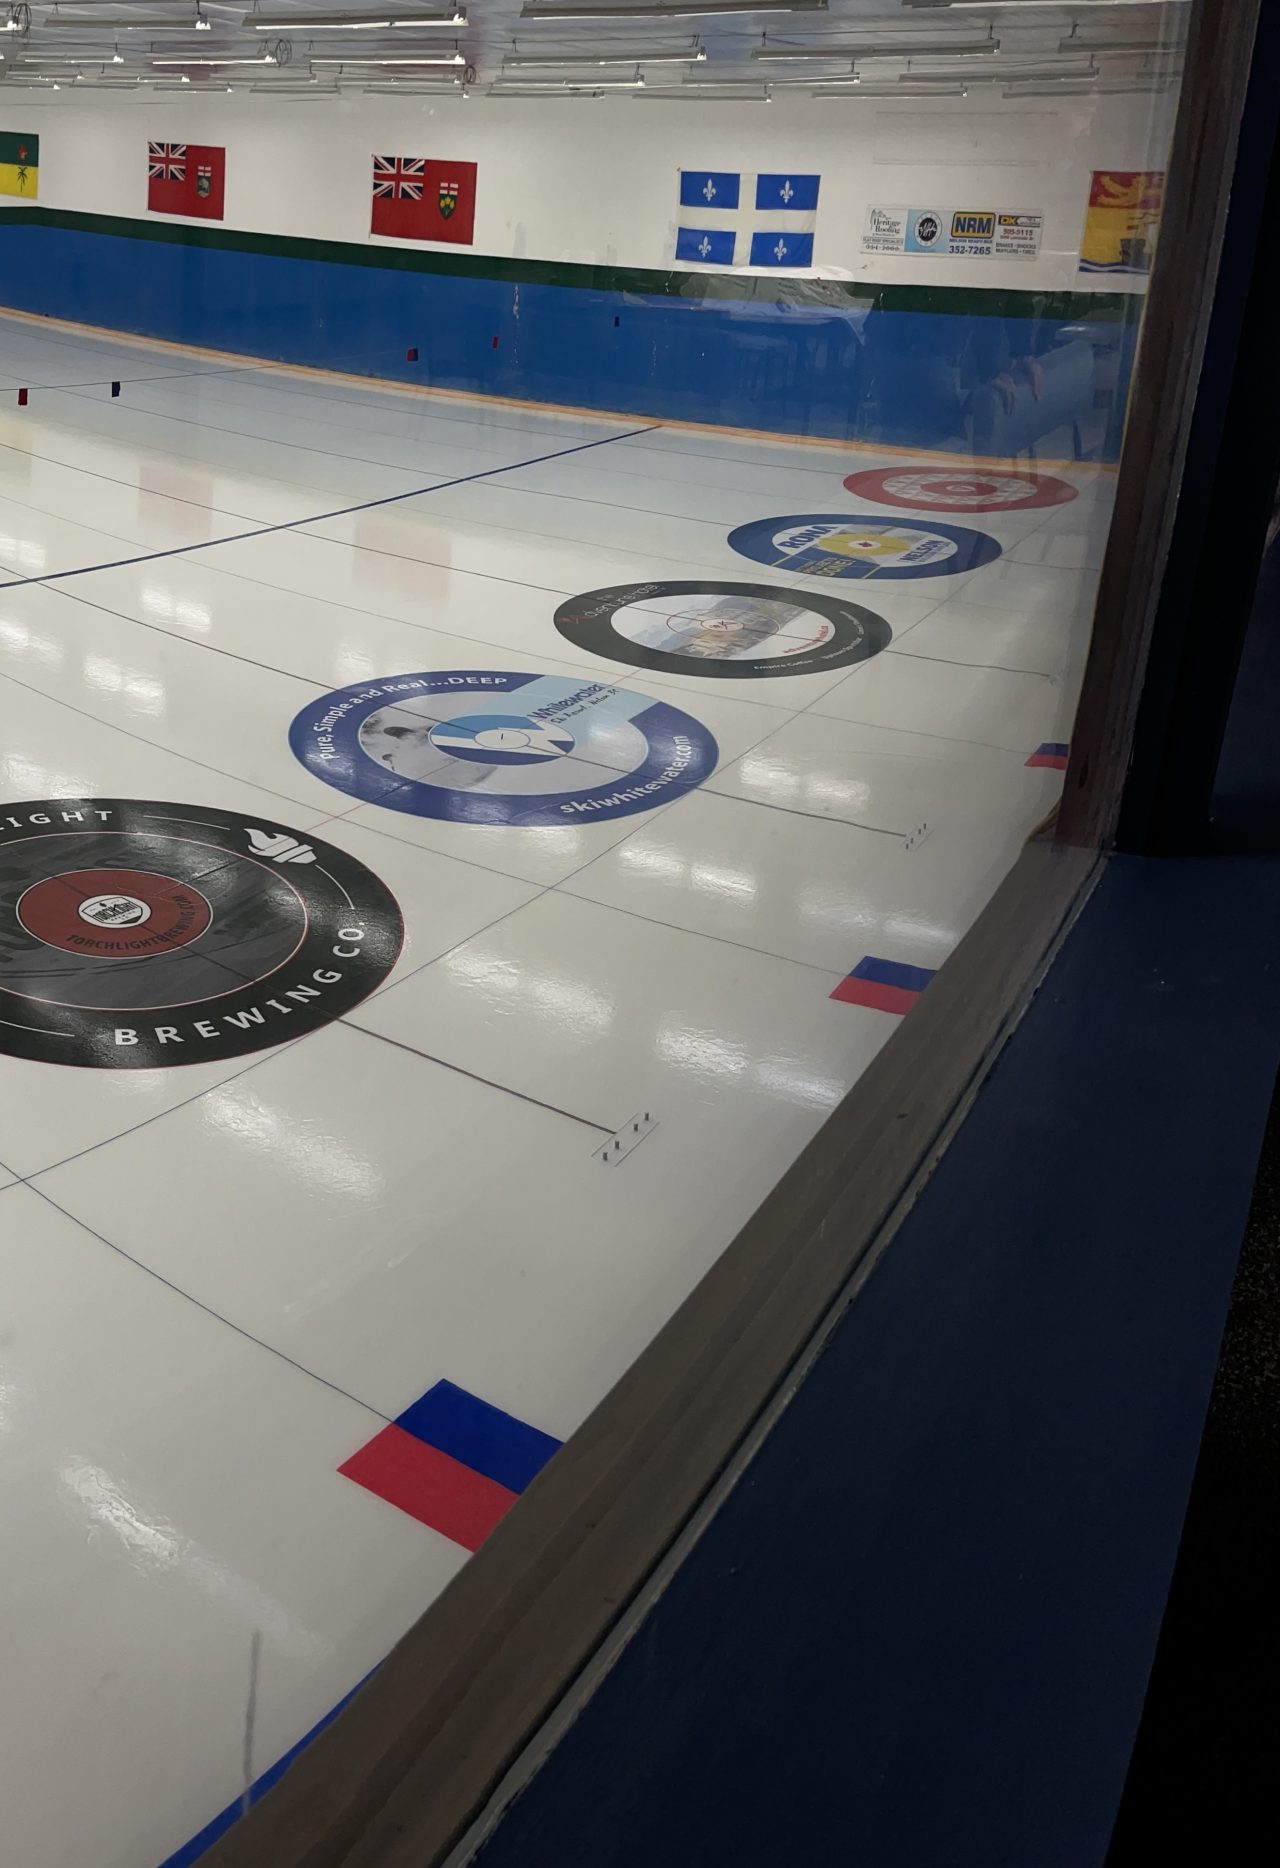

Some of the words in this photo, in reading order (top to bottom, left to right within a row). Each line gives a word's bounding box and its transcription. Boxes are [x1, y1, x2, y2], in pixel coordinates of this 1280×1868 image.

[955, 217, 992, 234] NRM
[949, 245, 991, 255] 352-7265
[777, 526, 838, 548] RONA
[313, 702, 353, 733] Simple
[349, 688, 384, 704] and
[526, 684, 606, 719] Whitewater
[560, 735, 692, 813] skiwhitewater.com
[114, 968, 343, 1046] BREWING
